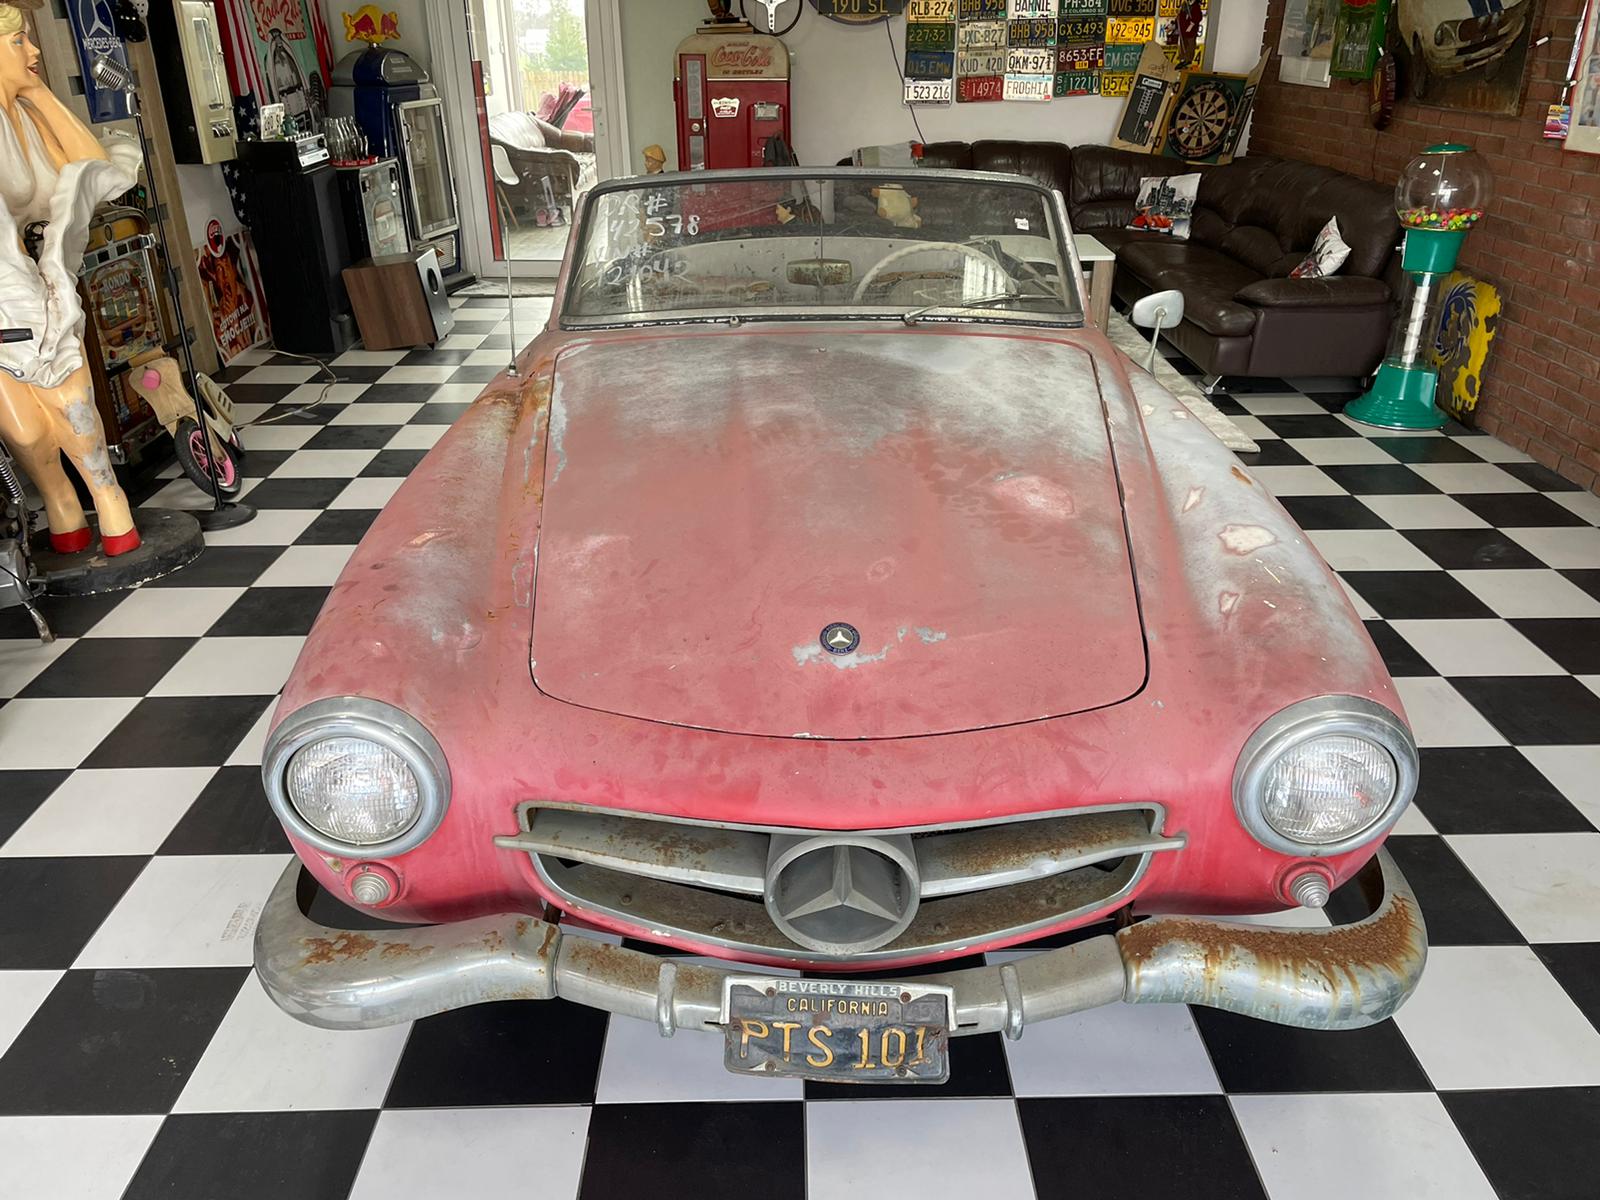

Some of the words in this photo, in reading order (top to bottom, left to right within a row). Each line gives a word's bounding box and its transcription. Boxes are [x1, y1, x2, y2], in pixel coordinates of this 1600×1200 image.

[868, 0, 889, 14] SL
[1034, 23, 1054, 38] 958
[1133, 23, 1151, 37] 945
[905, 86, 911, 99] T
[913, 85, 931, 99] 523
[932, 85, 950, 99] 216
[972, 81, 1001, 97] 14974
[778, 981, 847, 995] BEVERLY
[855, 984, 899, 997] HILLS
[787, 998, 889, 1016] CALIFORNIA
[738, 1019, 834, 1067] PTS
[852, 1025, 931, 1070] 101
